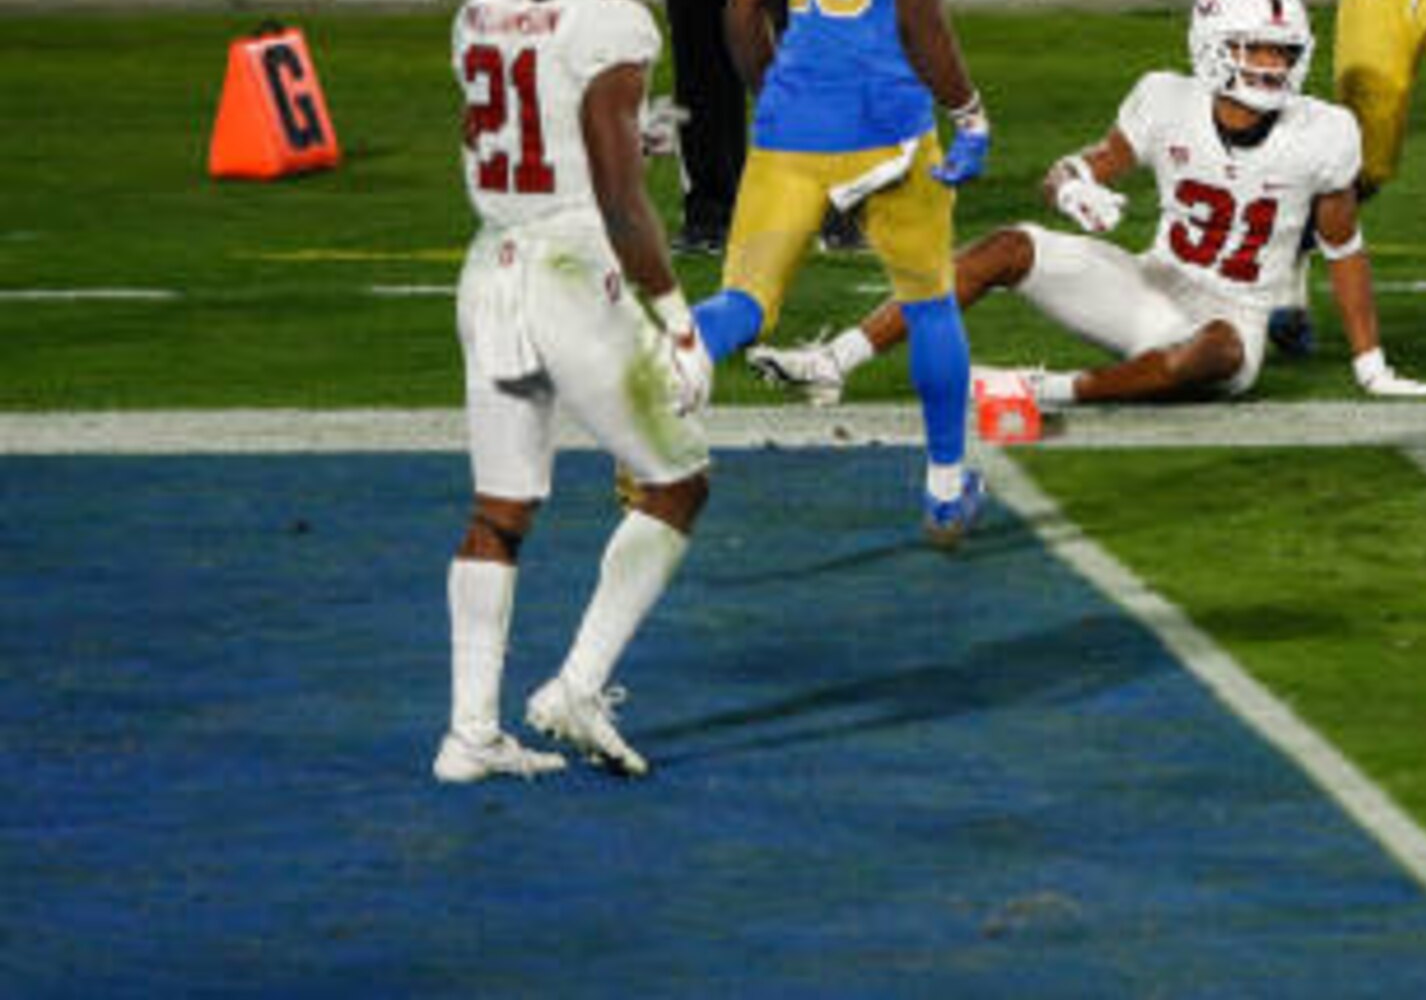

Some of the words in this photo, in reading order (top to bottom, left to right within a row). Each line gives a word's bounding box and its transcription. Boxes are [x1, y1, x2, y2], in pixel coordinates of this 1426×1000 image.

[261, 43, 326, 151] G
[463, 43, 556, 194] 21
[1169, 178, 1278, 283] 31
